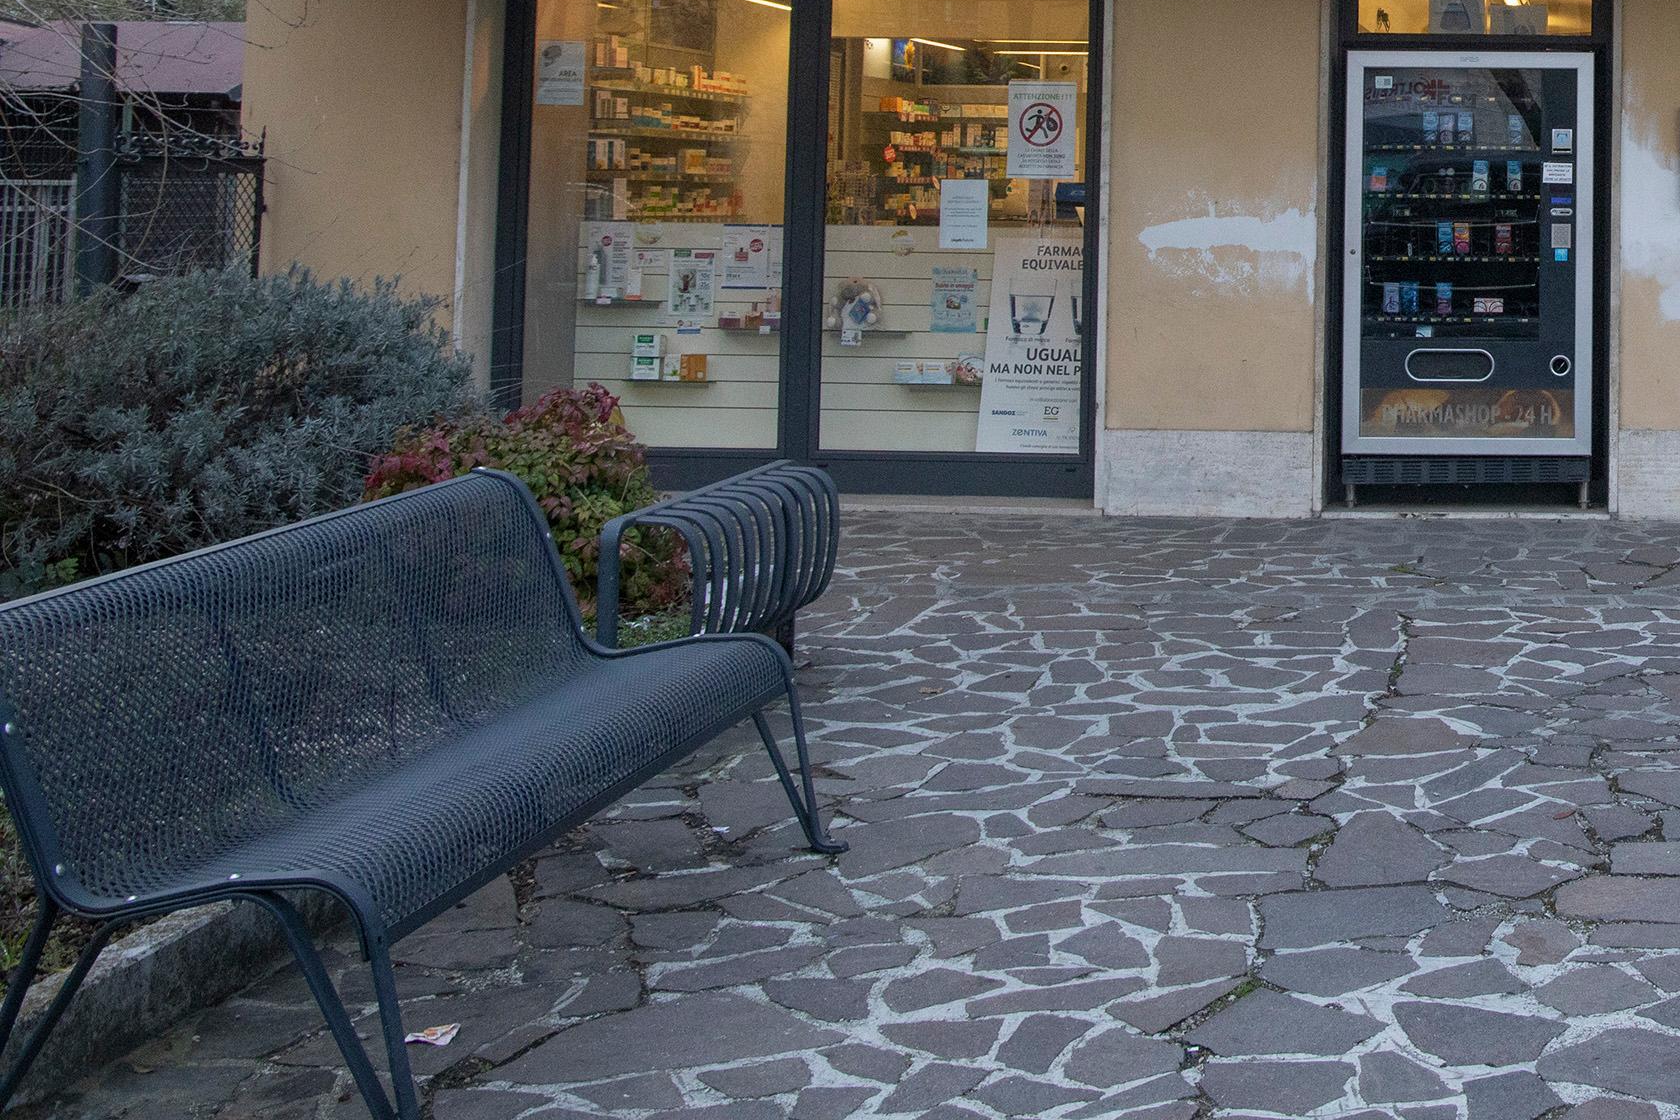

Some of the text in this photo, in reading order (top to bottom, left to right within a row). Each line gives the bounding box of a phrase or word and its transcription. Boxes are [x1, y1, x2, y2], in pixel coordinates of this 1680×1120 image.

[1022, 259, 1083, 271] EQUIVALE
[1027, 348, 1081, 362] UGUAL
[990, 363, 1010, 374] MA
[1014, 364, 1042, 375] NON
[1046, 364, 1070, 376] NEL
[1044, 406, 1060, 416] EG
[1517, 405, 1536, 425] 24
[1541, 405, 1552, 425] H
